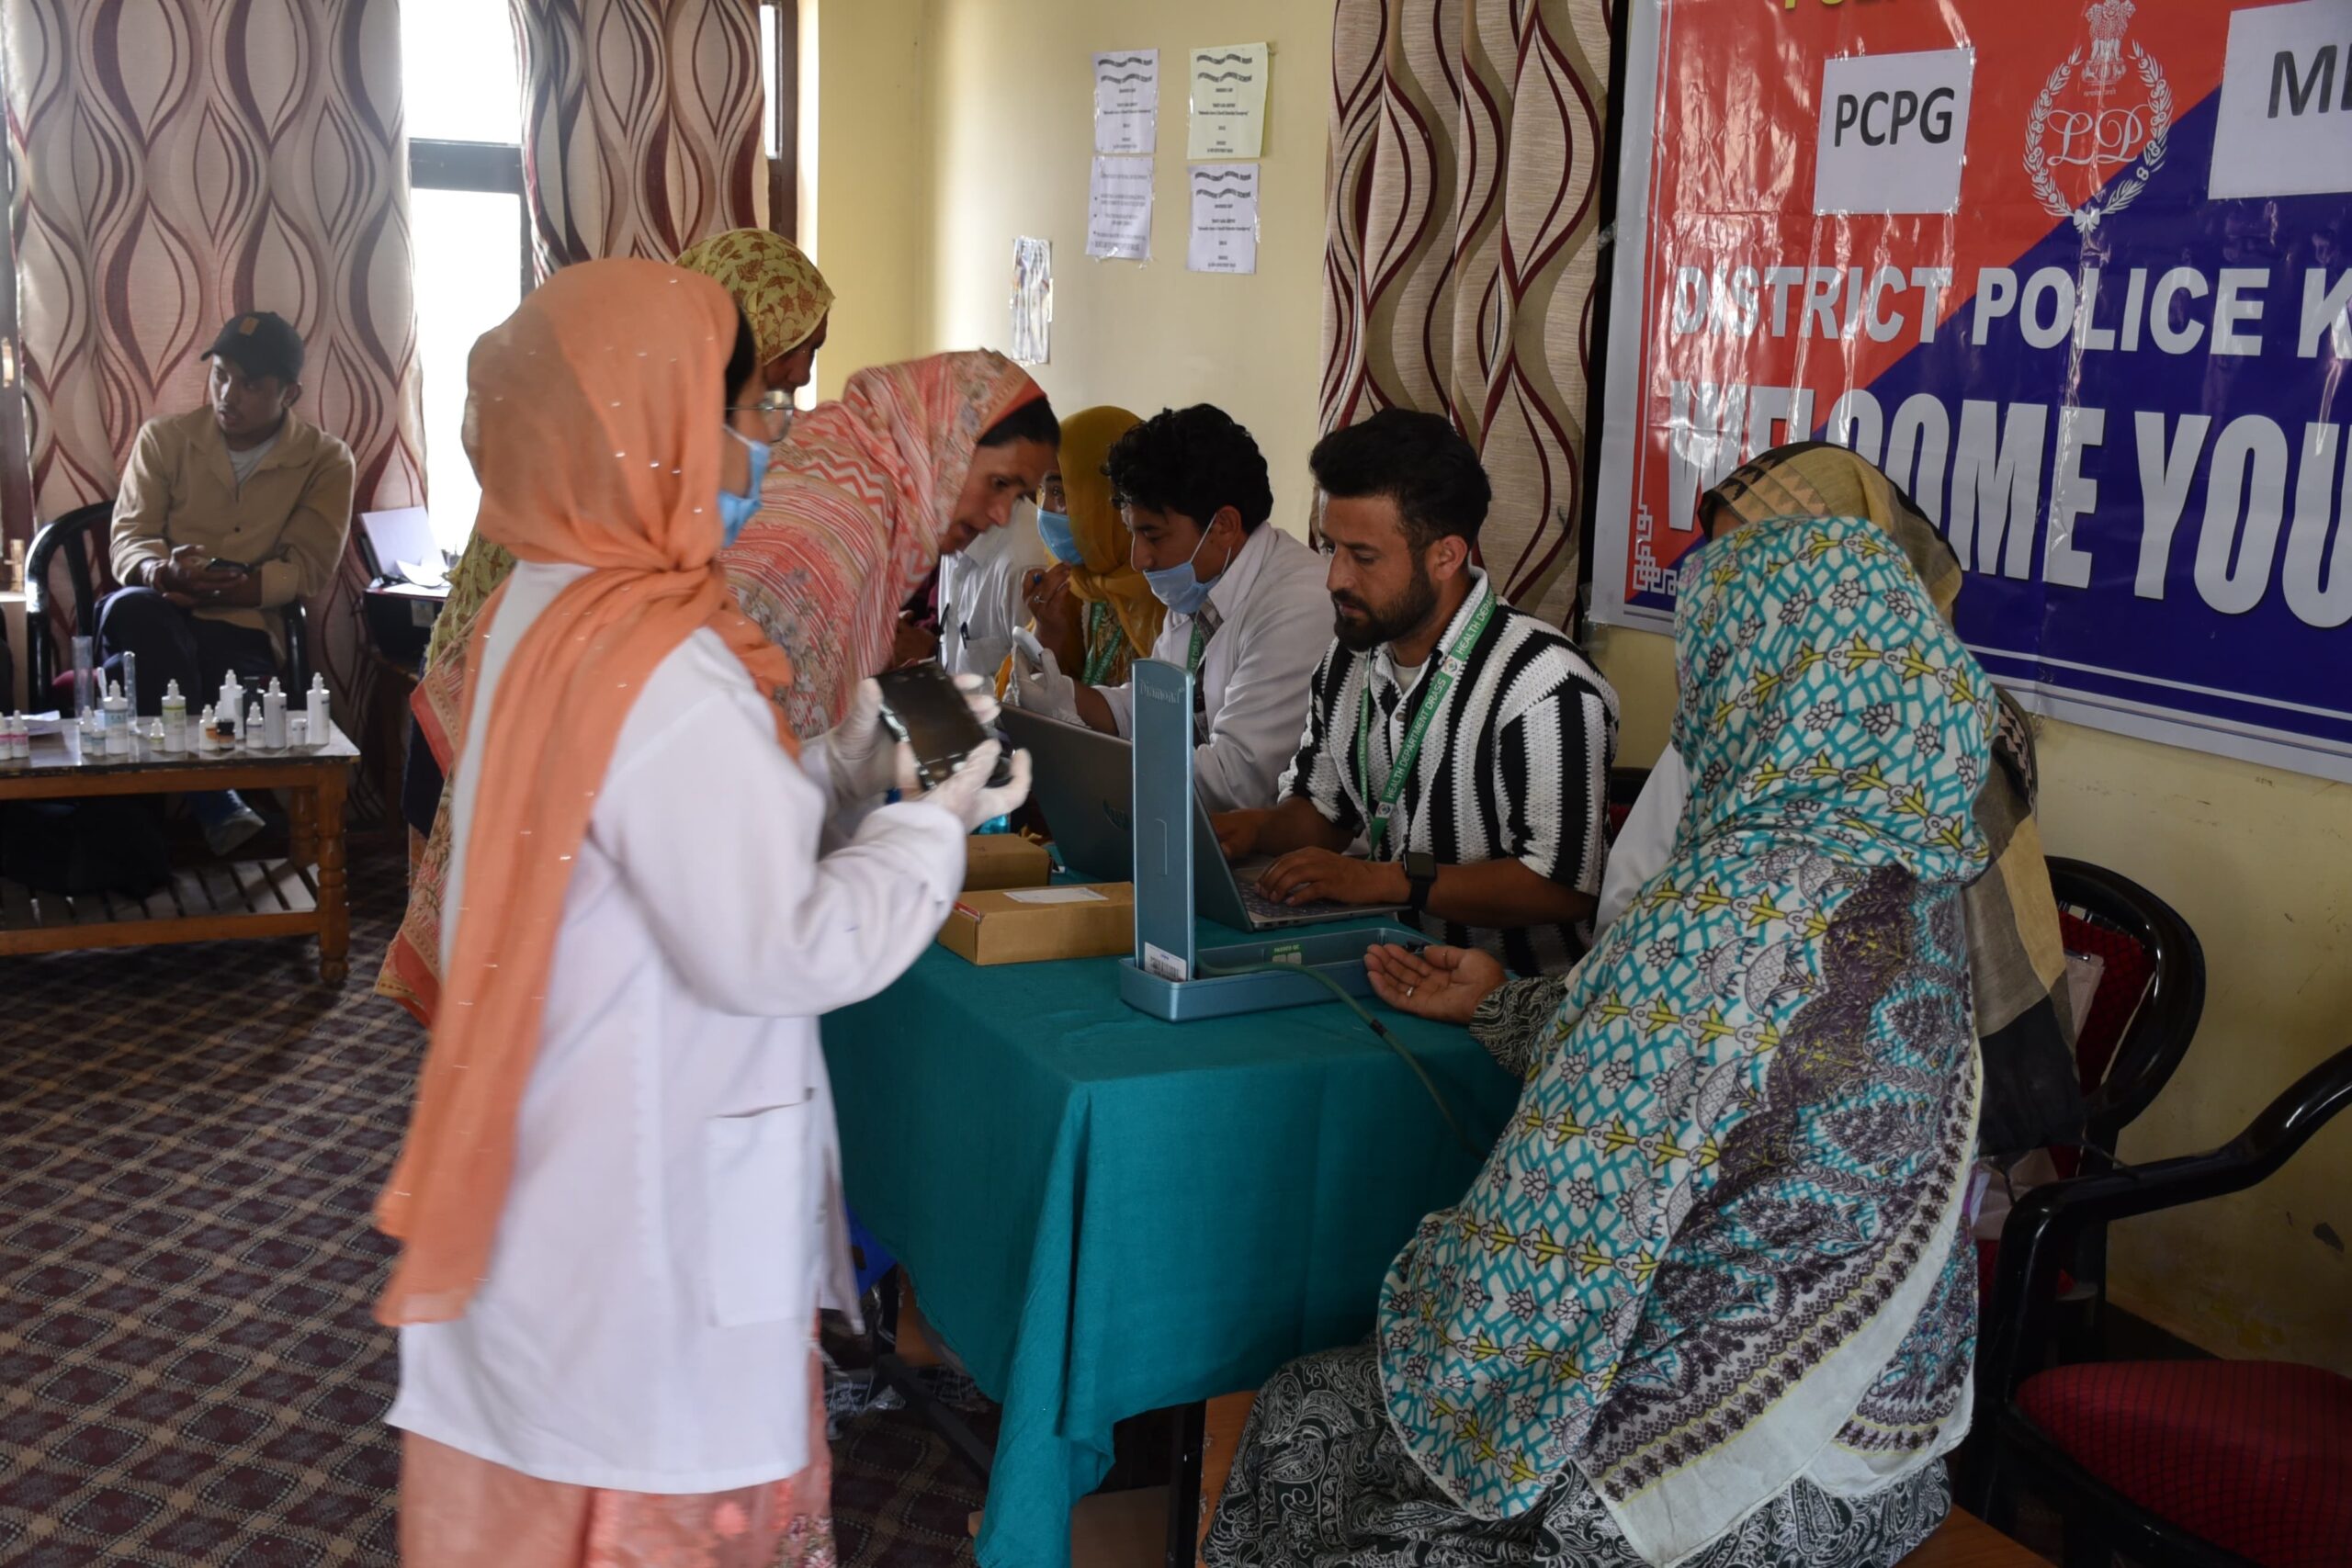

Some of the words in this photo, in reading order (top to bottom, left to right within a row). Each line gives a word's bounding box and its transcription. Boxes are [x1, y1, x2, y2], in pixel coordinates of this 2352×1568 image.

[1834, 86, 1955, 147] PCPG
[2267, 43, 2352, 118] M
[1672, 265, 1953, 344] DISTRICT
[1971, 265, 2270, 356] POLICE
[2134, 411, 2352, 628] YOU
[1455, 620, 1481, 656] HEALTH
[1386, 767, 1406, 800] HEALTH
[1399, 710, 1429, 768] DEPARTMENT
[1425, 677, 1446, 711] DRASS
